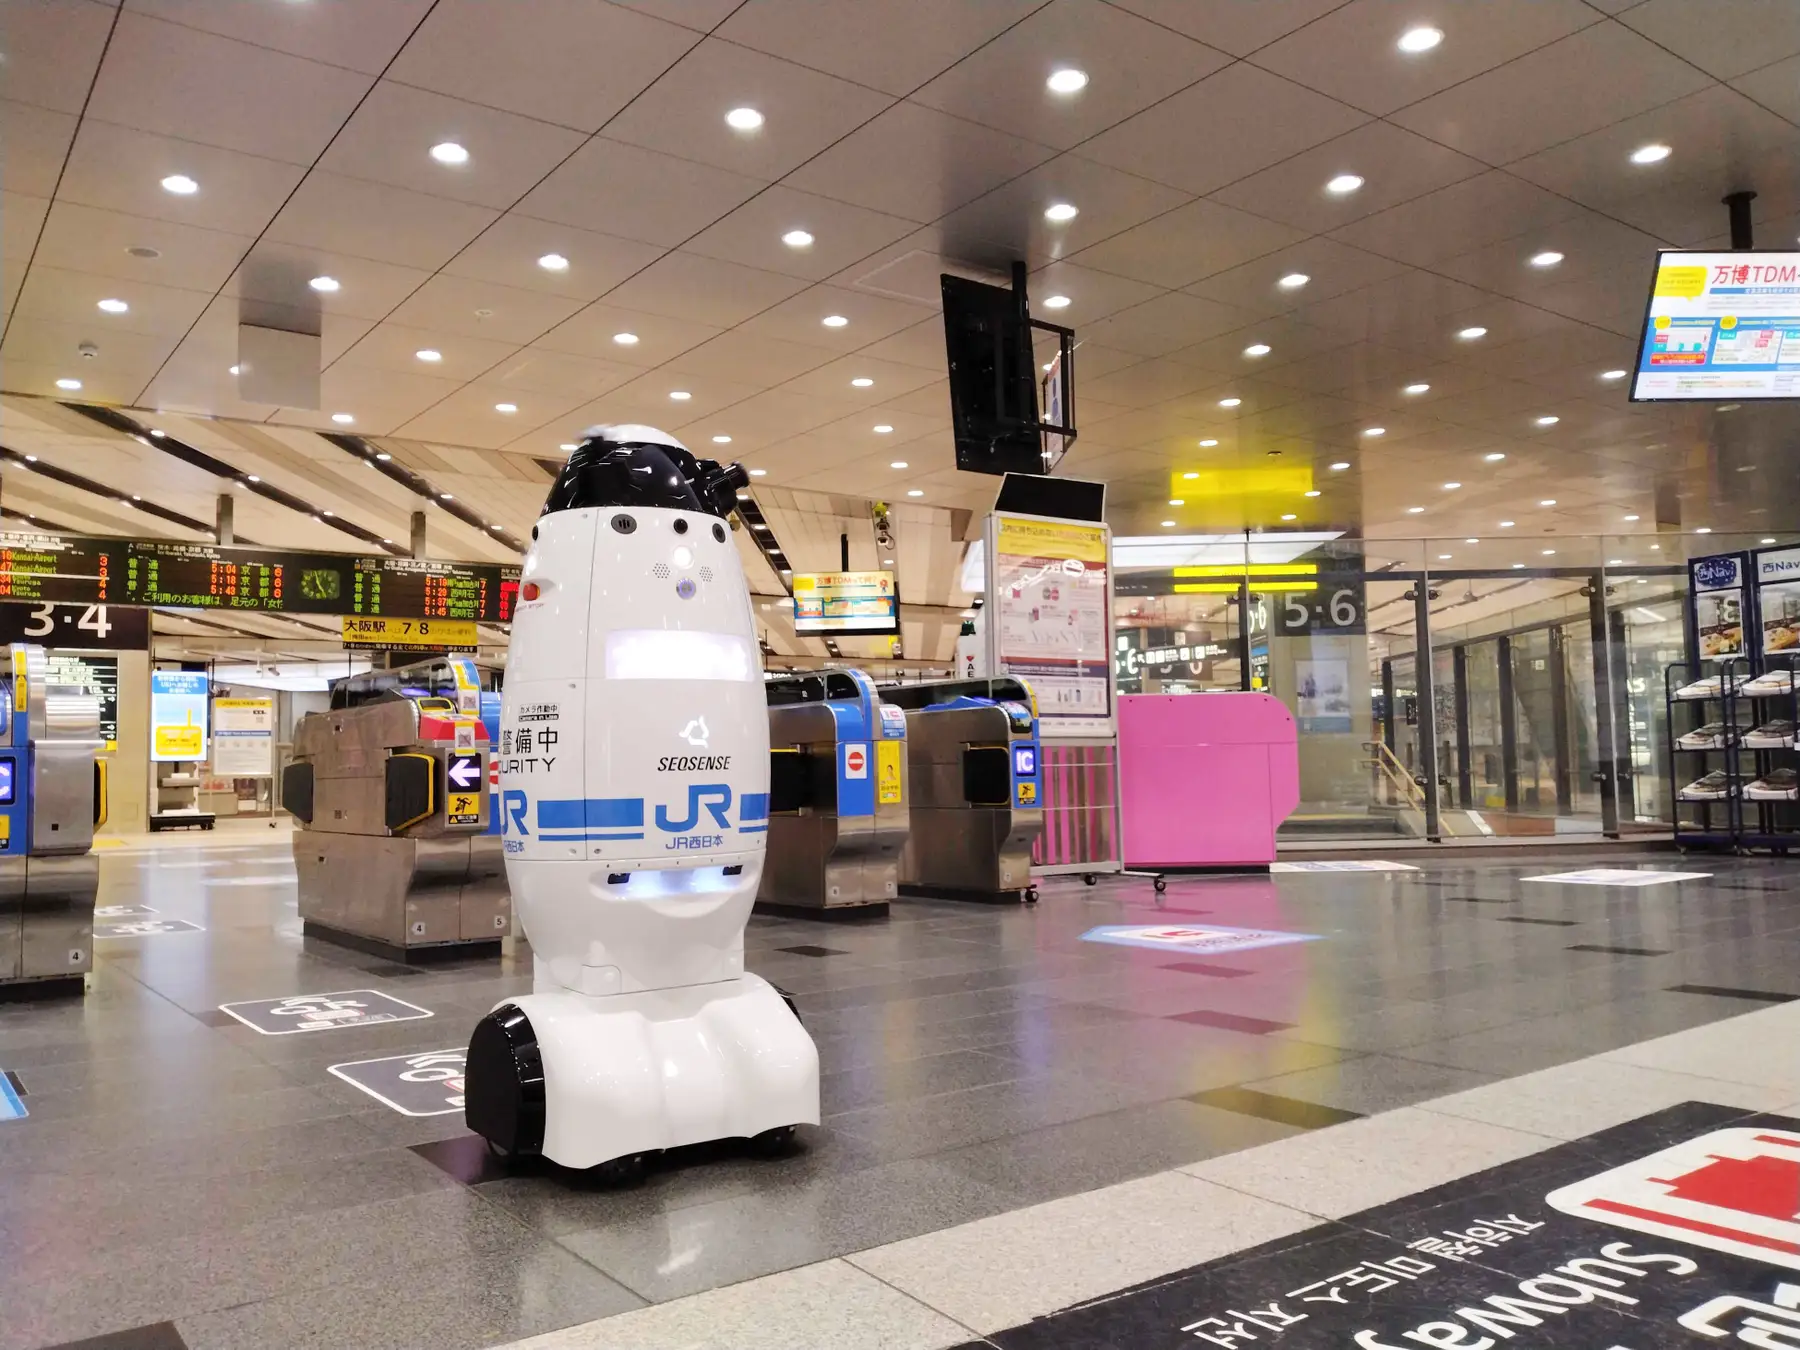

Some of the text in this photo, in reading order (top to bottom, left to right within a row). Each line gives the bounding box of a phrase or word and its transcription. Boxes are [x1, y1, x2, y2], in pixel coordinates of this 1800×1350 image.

[1712, 264, 1800, 285] 万博TDM
[99, 556, 108, 566] 3
[99, 567, 108, 577] 3
[274, 567, 283, 578] 6
[99, 577, 107, 588] 4
[274, 578, 282, 588] 6
[480, 581, 487, 590] 7
[98, 590, 107, 600] 4
[273, 588, 282, 598] 6
[480, 590, 486, 599] 7
[480, 599, 486, 609] 7
[424, 607, 447, 617] 5:45
[479, 609, 486, 618] 7
[967, 663, 975, 678] AE
[520, 704, 558, 713] カメラ作動中
[498, 757, 556, 774] URITY
[657, 755, 732, 772] SEQSENSE
[1015, 751, 1034, 772] IC
[655, 783, 732, 833] JR
[665, 834, 724, 850] JR西日本
[496, 918, 502, 926] 5
[416, 924, 423, 933] 4
[72, 951, 80, 961] 4
[1406, 1213, 1546, 1262] 지하철
